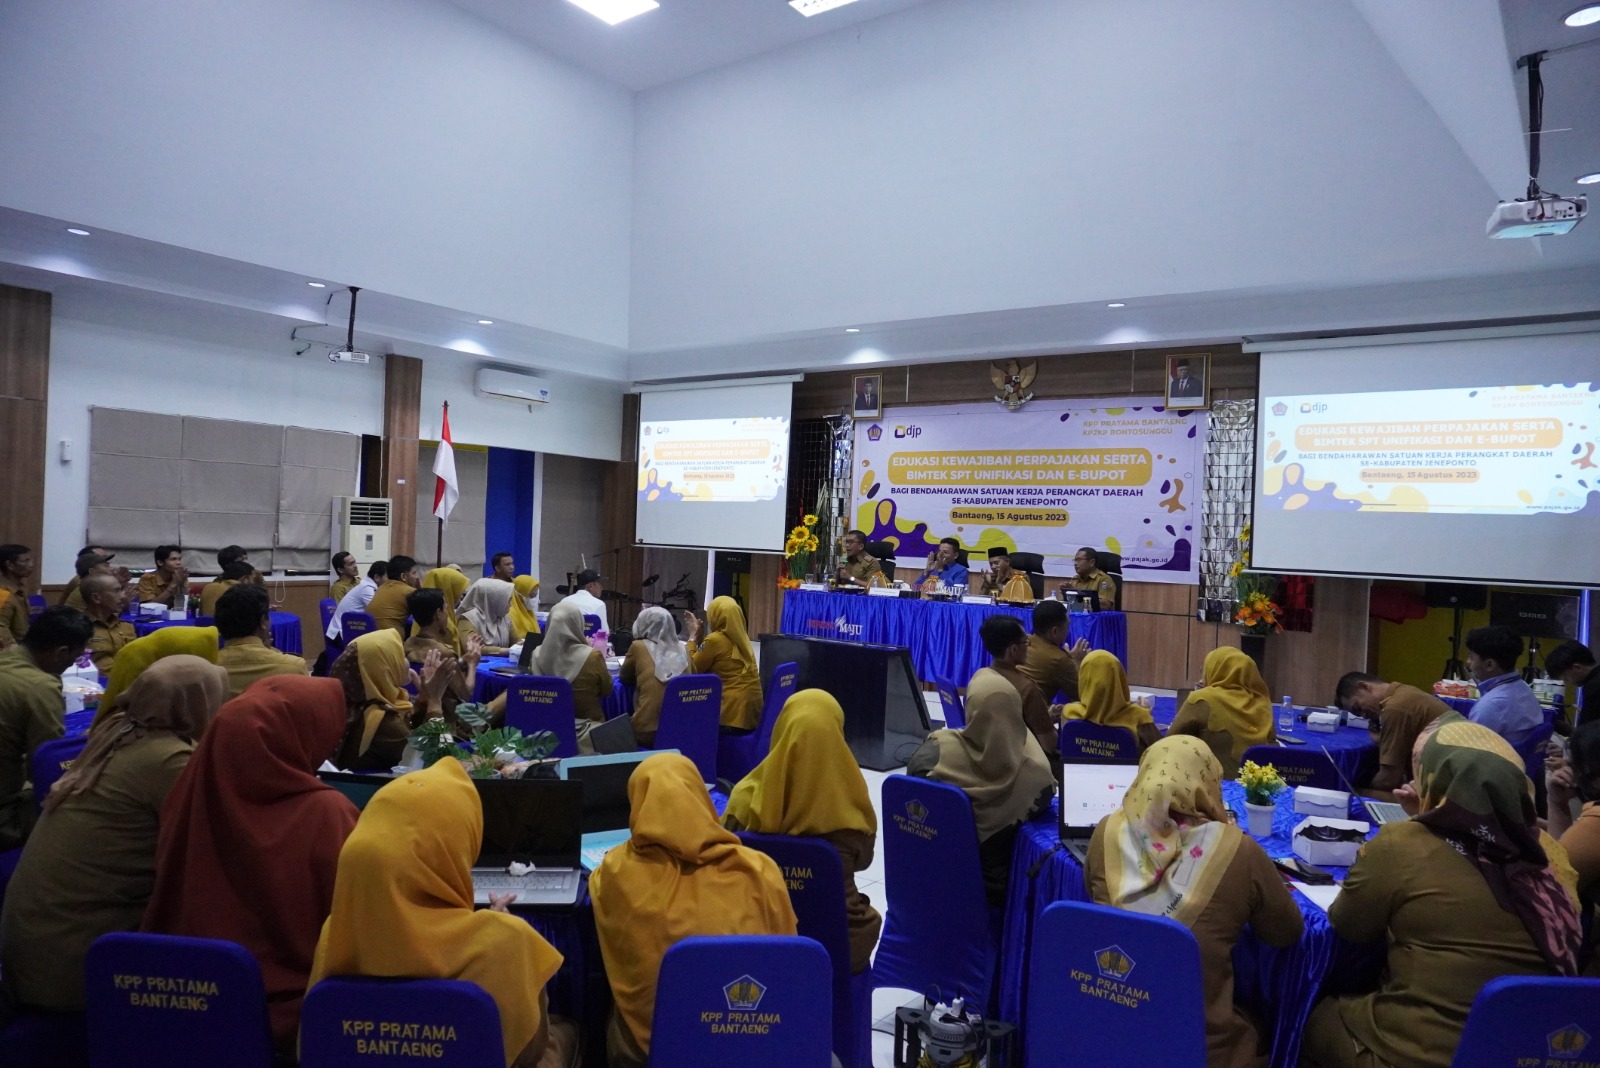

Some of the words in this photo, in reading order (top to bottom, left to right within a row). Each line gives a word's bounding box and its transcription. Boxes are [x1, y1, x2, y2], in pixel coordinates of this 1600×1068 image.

[1312, 402, 1328, 413] djp
[1141, 418, 1187, 426] BANTAENG
[1299, 427, 1347, 435] EDUKASI
[1350, 425, 1421, 434] KEWAJIBAN
[1424, 423, 1508, 432] PERPAJAKAN
[1512, 421, 1556, 431] SERTA
[906, 425, 921, 438] djp
[1314, 438, 1356, 446] BIMTEK
[1359, 437, 1380, 446] SPT
[1382, 436, 1442, 445] UNIFIKASI
[1446, 436, 1472, 445] DAN
[1477, 434, 1537, 444] E-BUPOT
[892, 457, 939, 466] EDUKASI
[942, 455, 1012, 466] KEWAJIBAN
[1015, 455, 1100, 465] PERPAJAKAN
[1103, 454, 1147, 464] SERTA
[907, 471, 947, 480] BIMTEK
[950, 470, 971, 480] SPT
[974, 470, 1033, 480] UNIFIKASI
[1036, 470, 1065, 480] DAN
[1068, 469, 1127, 480] E-BUPOT
[1362, 472, 1405, 480] Bantaeng,
[1417, 472, 1453, 480] Agustus
[1016, 488, 1044, 496] KERJA
[1046, 488, 1100, 496] PERANGKAT
[1016, 498, 1068, 506] JENEPONTO
[952, 512, 994, 521] Bantaeng,
[996, 512, 1005, 520] 15
[1007, 513, 1042, 522] Agustus
[840, 623, 863, 635] MAJU
[1090, 739, 1120, 751] PRATAMA
[1081, 746, 1115, 757] BANTAENG
[1278, 767, 1315, 775] PRATAMA
[899, 822, 932, 840] BANTAENG
[908, 820, 937, 836] PRATAMA
[780, 866, 813, 879] TAMA
[114, 975, 142, 989] KPP
[147, 977, 219, 996] PRATAMA
[1071, 969, 1092, 982] KPP
[1097, 978, 1150, 1001] PRATAMA
[130, 993, 208, 1011] BANTAENG
[1081, 984, 1138, 1008] BANTAENG
[701, 1012, 723, 1022] KPP
[728, 1013, 781, 1023] PRATAMA
[342, 1020, 374, 1036] KPP
[380, 1022, 457, 1041] PRATAMA
[711, 1024, 769, 1034] BANTAENG
[357, 1040, 443, 1058] BANTAENG
